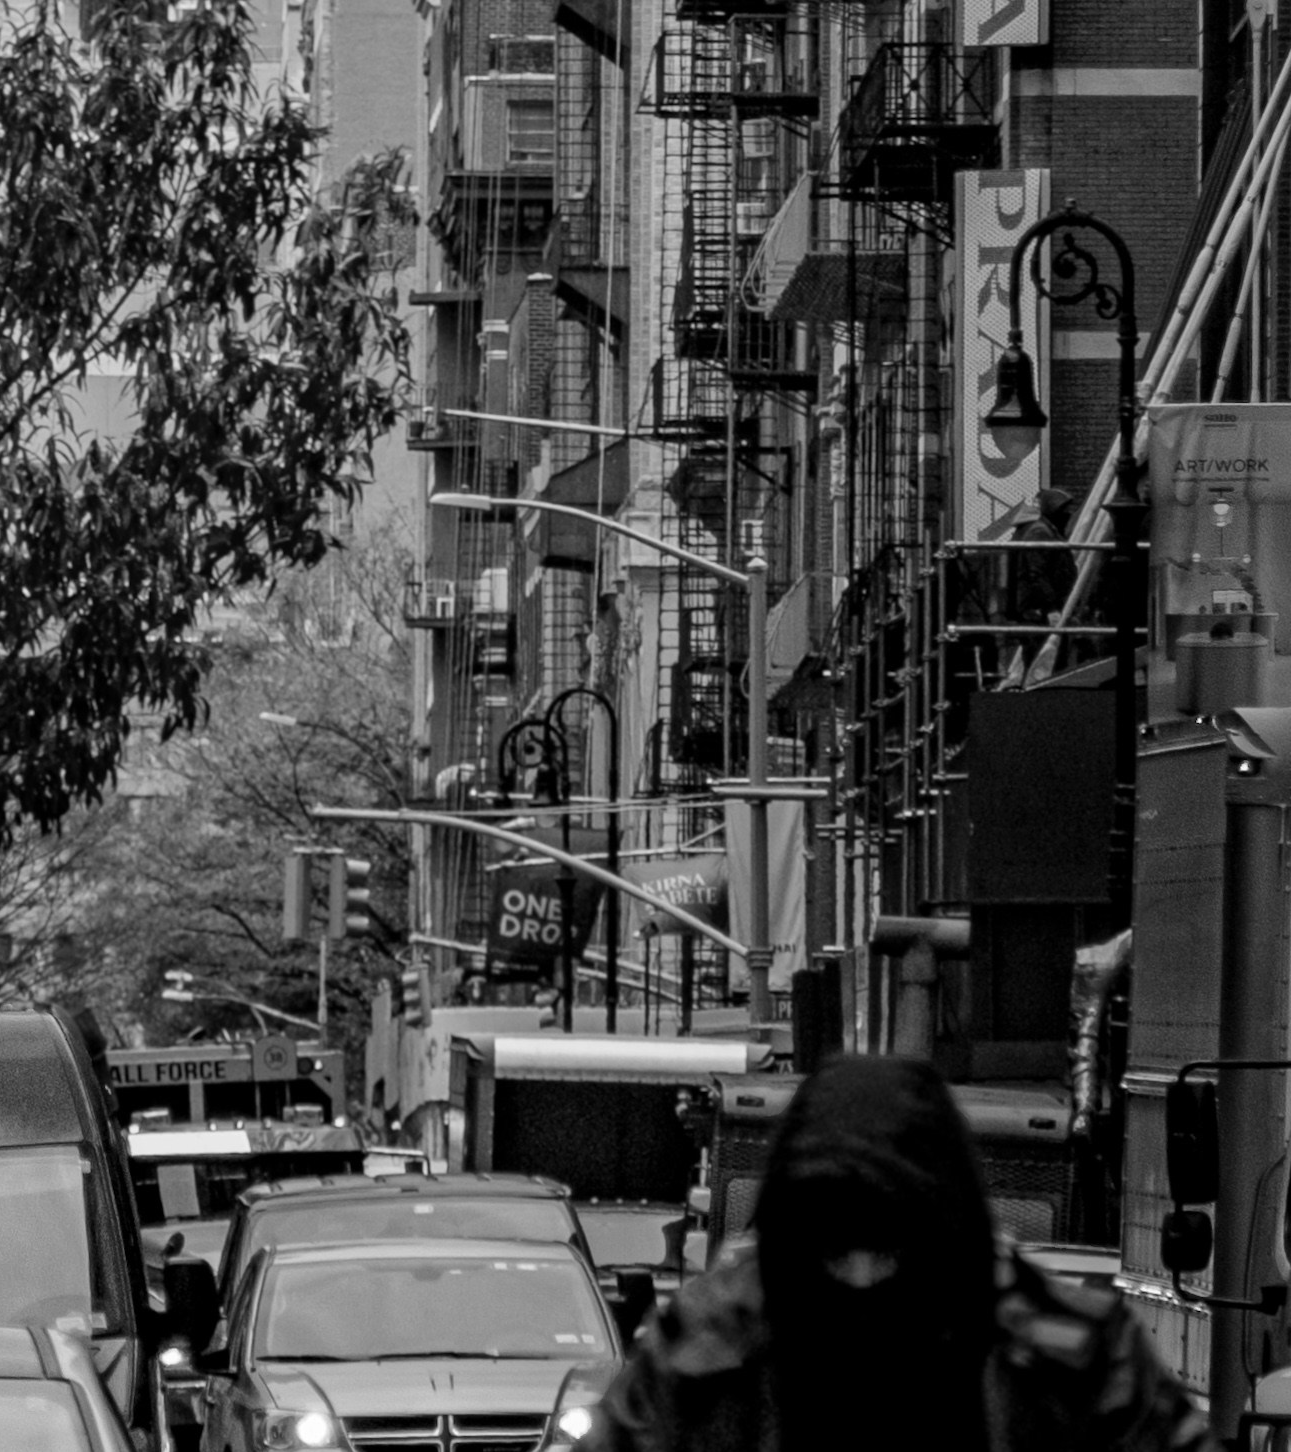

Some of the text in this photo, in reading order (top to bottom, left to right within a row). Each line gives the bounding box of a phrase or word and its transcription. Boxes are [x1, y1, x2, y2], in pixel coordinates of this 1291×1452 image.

[1174, 458, 1269, 474] ART/WORK
[502, 888, 563, 922] ONE
[657, 886, 718, 905] ABETE
[156, 1060, 227, 1082] FORCE
